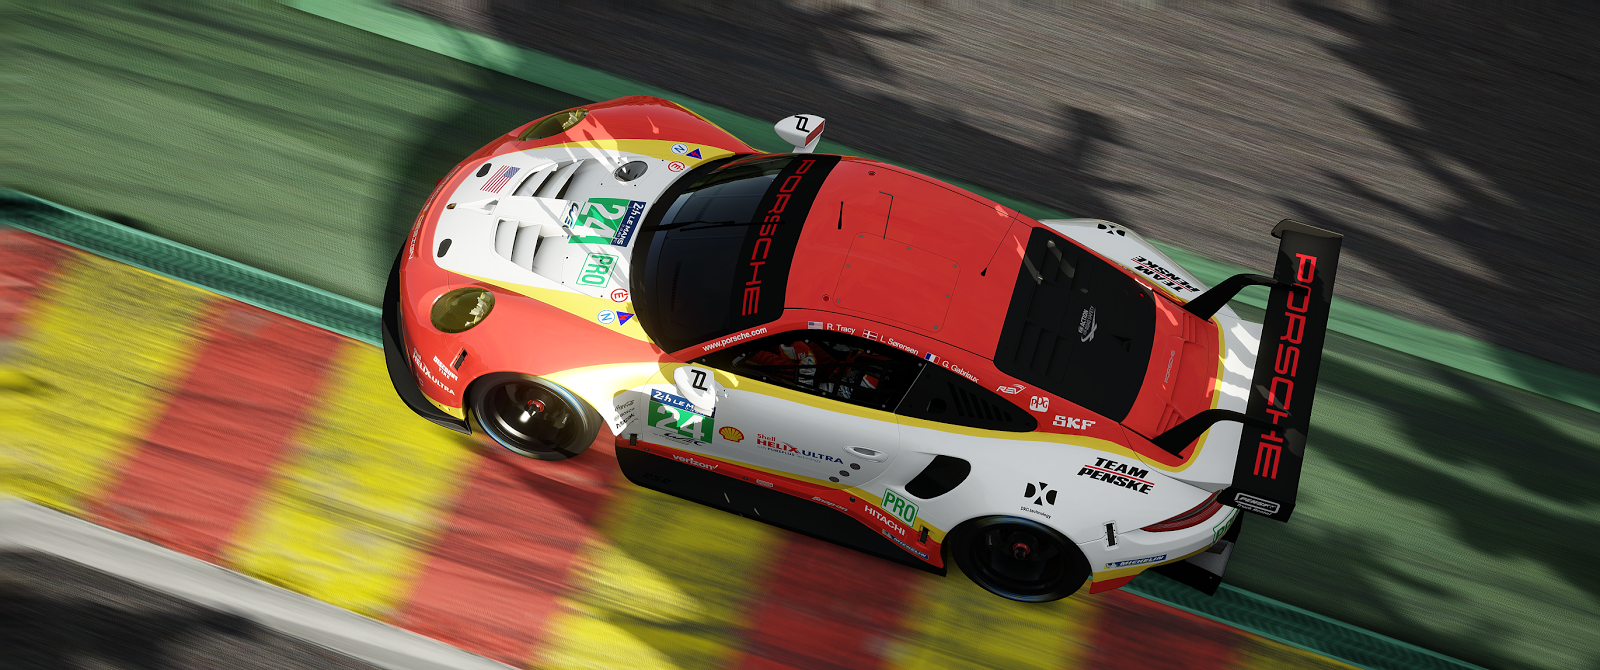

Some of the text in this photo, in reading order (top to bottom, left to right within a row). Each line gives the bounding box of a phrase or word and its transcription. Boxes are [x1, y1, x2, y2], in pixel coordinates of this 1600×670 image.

[626, 215, 636, 226] LE
[616, 225, 631, 246] MANS
[742, 159, 817, 317] PORSCHE
[581, 254, 615, 286] PRO
[702, 326, 768, 352] www.porsche.com
[826, 323, 857, 335] R. Tracy
[941, 360, 951, 369] G.
[1252, 253, 1318, 480] PORSCHE
[431, 375, 456, 396] ULTRA
[1029, 396, 1049, 412] PPG
[655, 405, 706, 441] 24
[1052, 414, 1097, 430] SKF
[757, 433, 776, 442] Shell
[672, 454, 715, 471] verizon
[756, 439, 844, 464] HELIX ULTRA
[1094, 456, 1150, 479] TEAM
[1077, 467, 1154, 495] PENSKE
[882, 491, 917, 523] PRO
[864, 505, 906, 536] HITACHI
